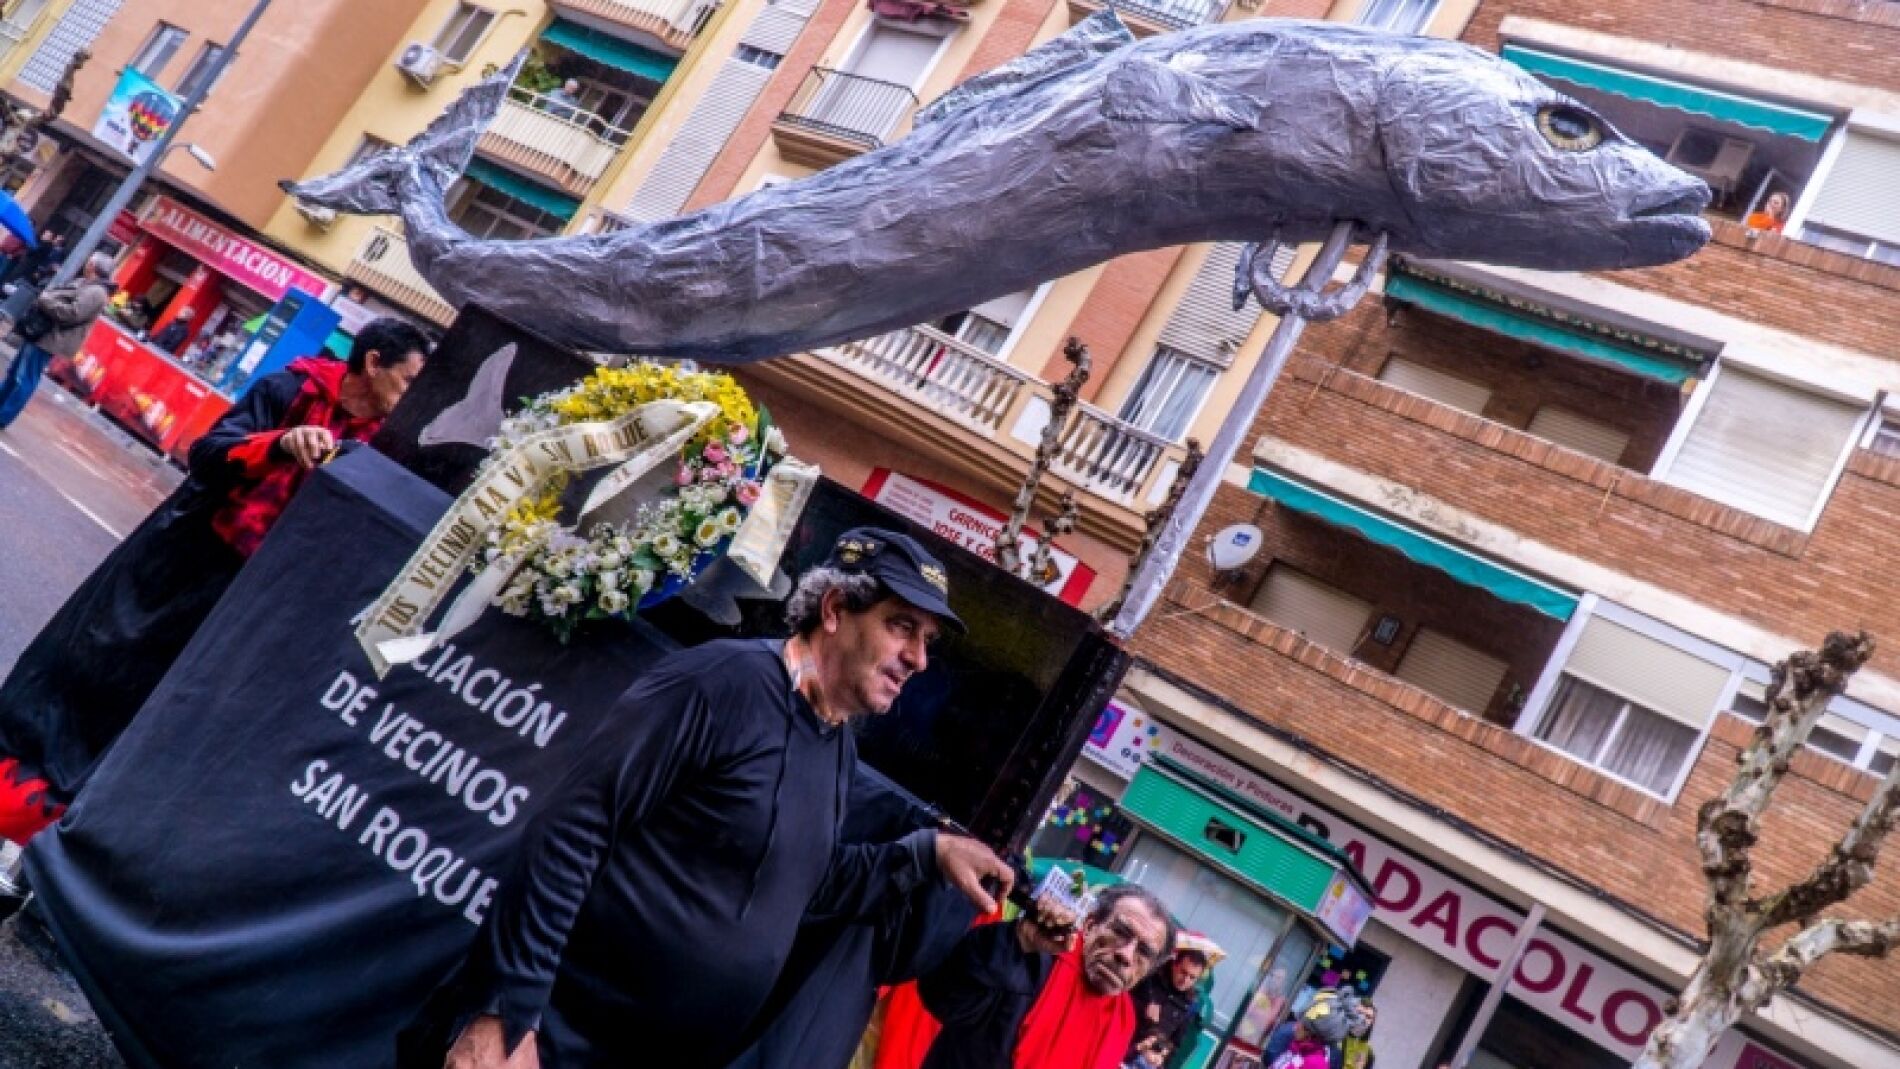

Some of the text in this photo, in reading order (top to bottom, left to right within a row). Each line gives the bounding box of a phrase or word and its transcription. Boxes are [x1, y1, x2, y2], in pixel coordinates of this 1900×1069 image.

[163, 206, 293, 288] ALIMENTACION
[376, 596, 418, 635] TUS
[410, 515, 476, 589] VECINOS
[474, 486, 509, 521] AA
[320, 670, 530, 826] DE VECINOS
[1246, 780, 1293, 815] Pinturas
[290, 759, 500, 926] SAN ROQUE
[1297, 811, 1717, 1057] ADACOLO
